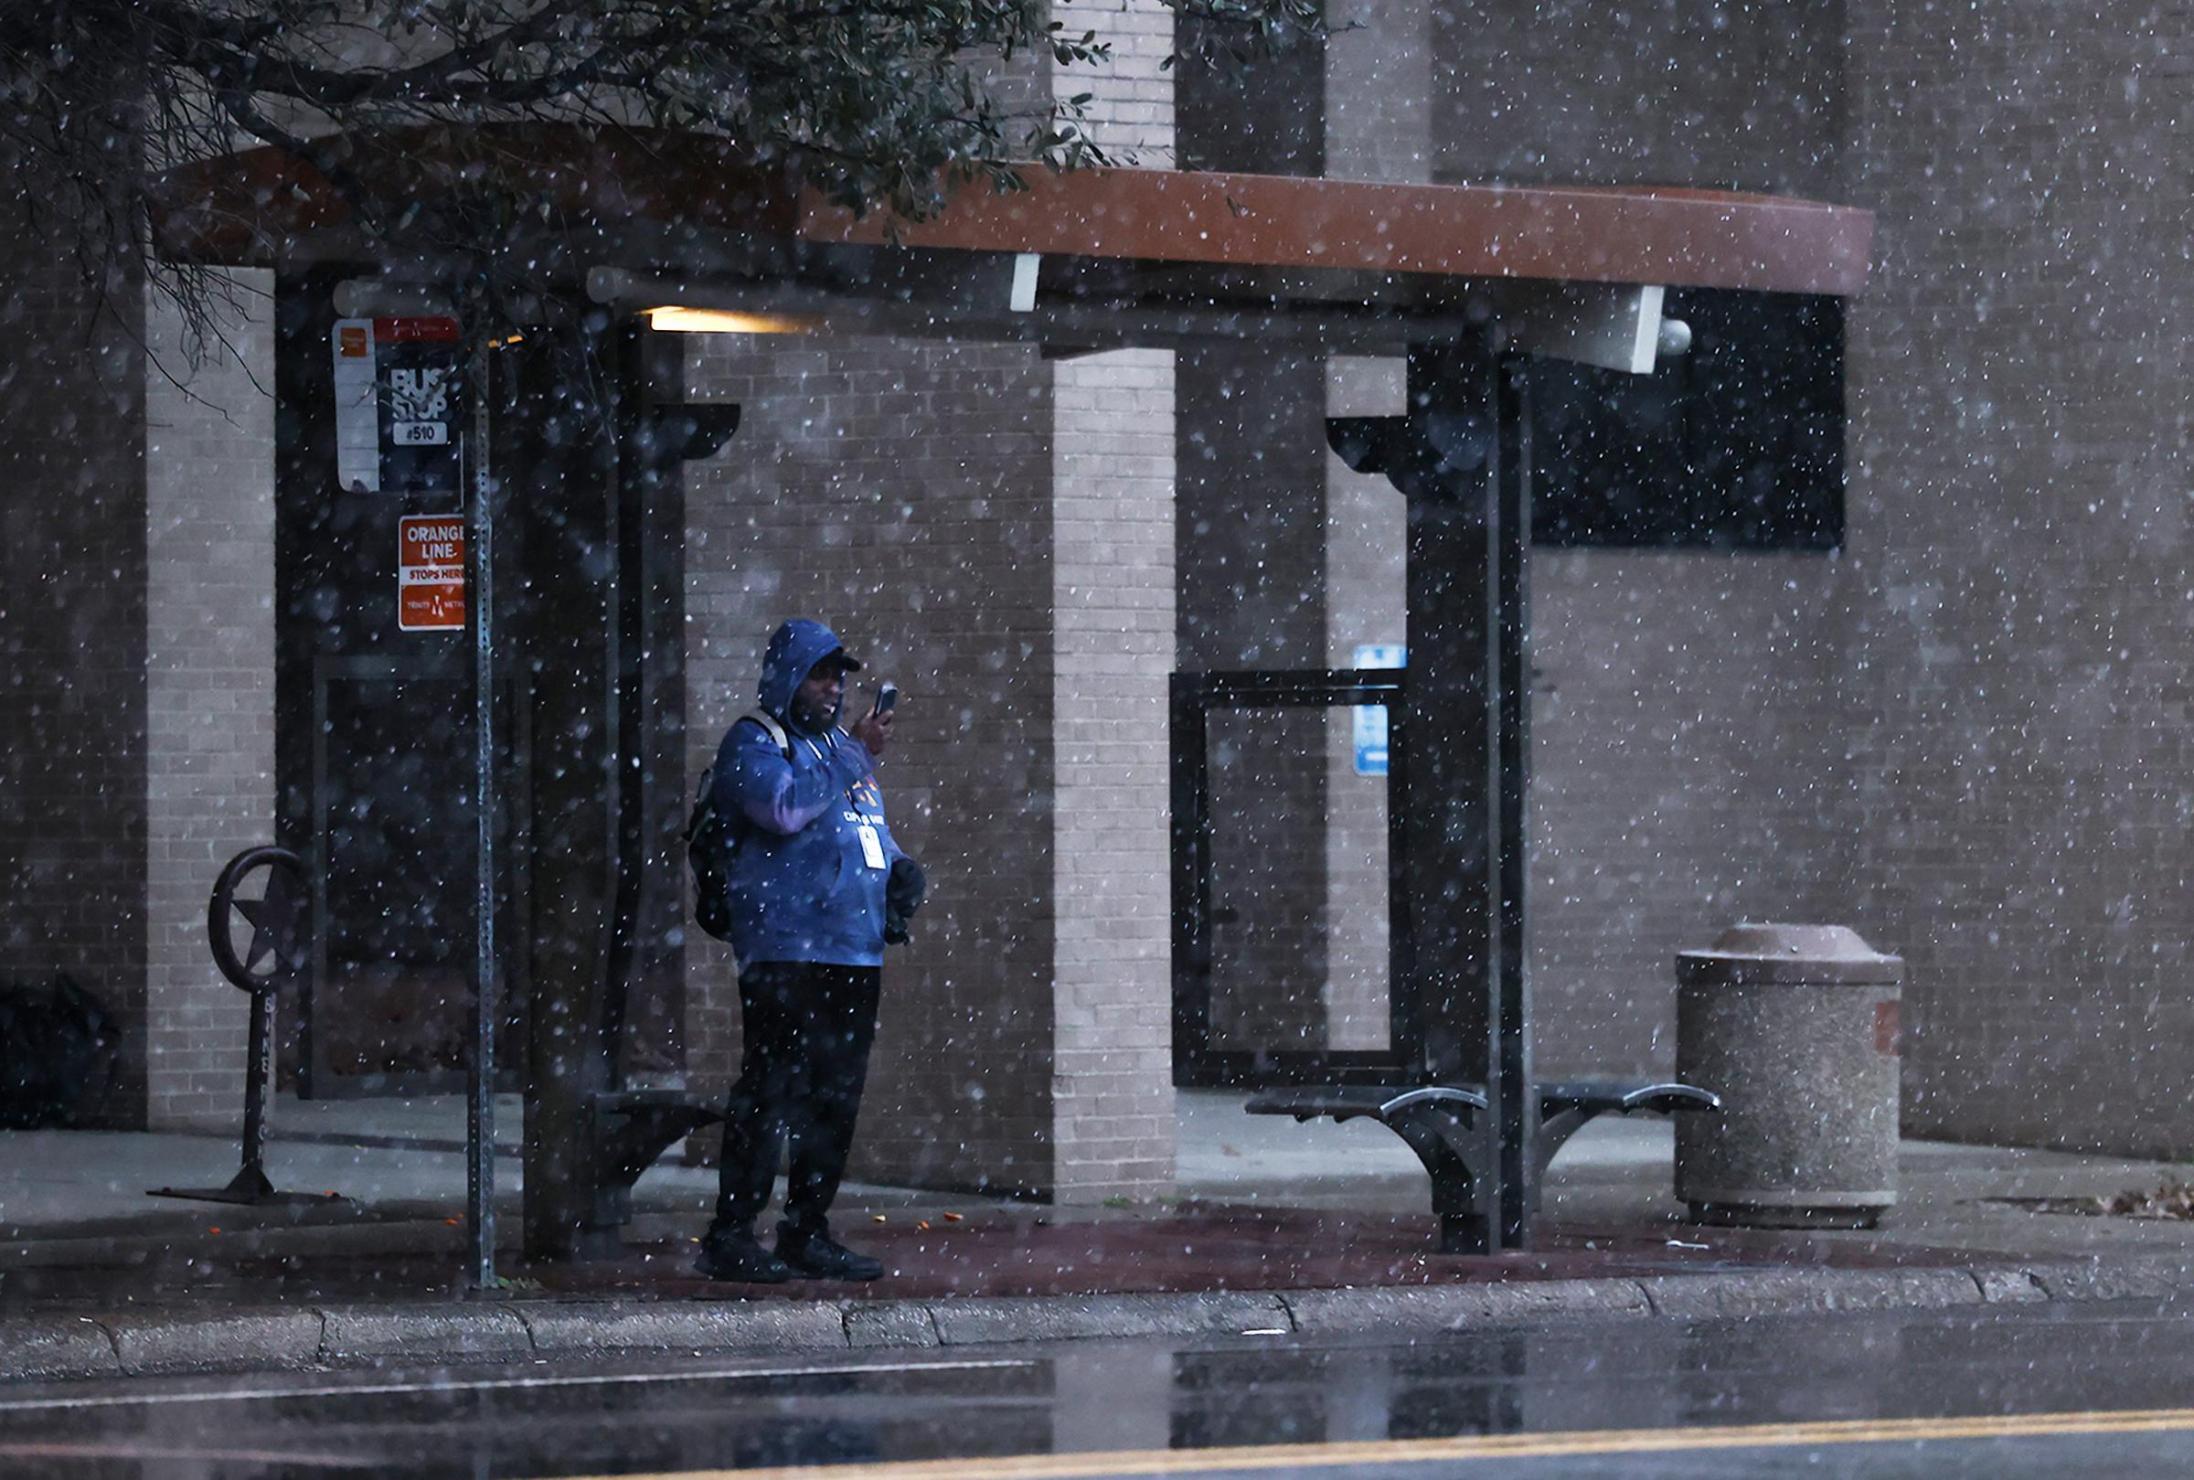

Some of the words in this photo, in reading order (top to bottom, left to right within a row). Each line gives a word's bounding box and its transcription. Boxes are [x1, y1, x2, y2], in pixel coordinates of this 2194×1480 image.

[391, 369, 447, 396] BUS
[406, 425, 435, 440] #510
[422, 543, 454, 559] LINE
[409, 569, 440, 580] STOPS
